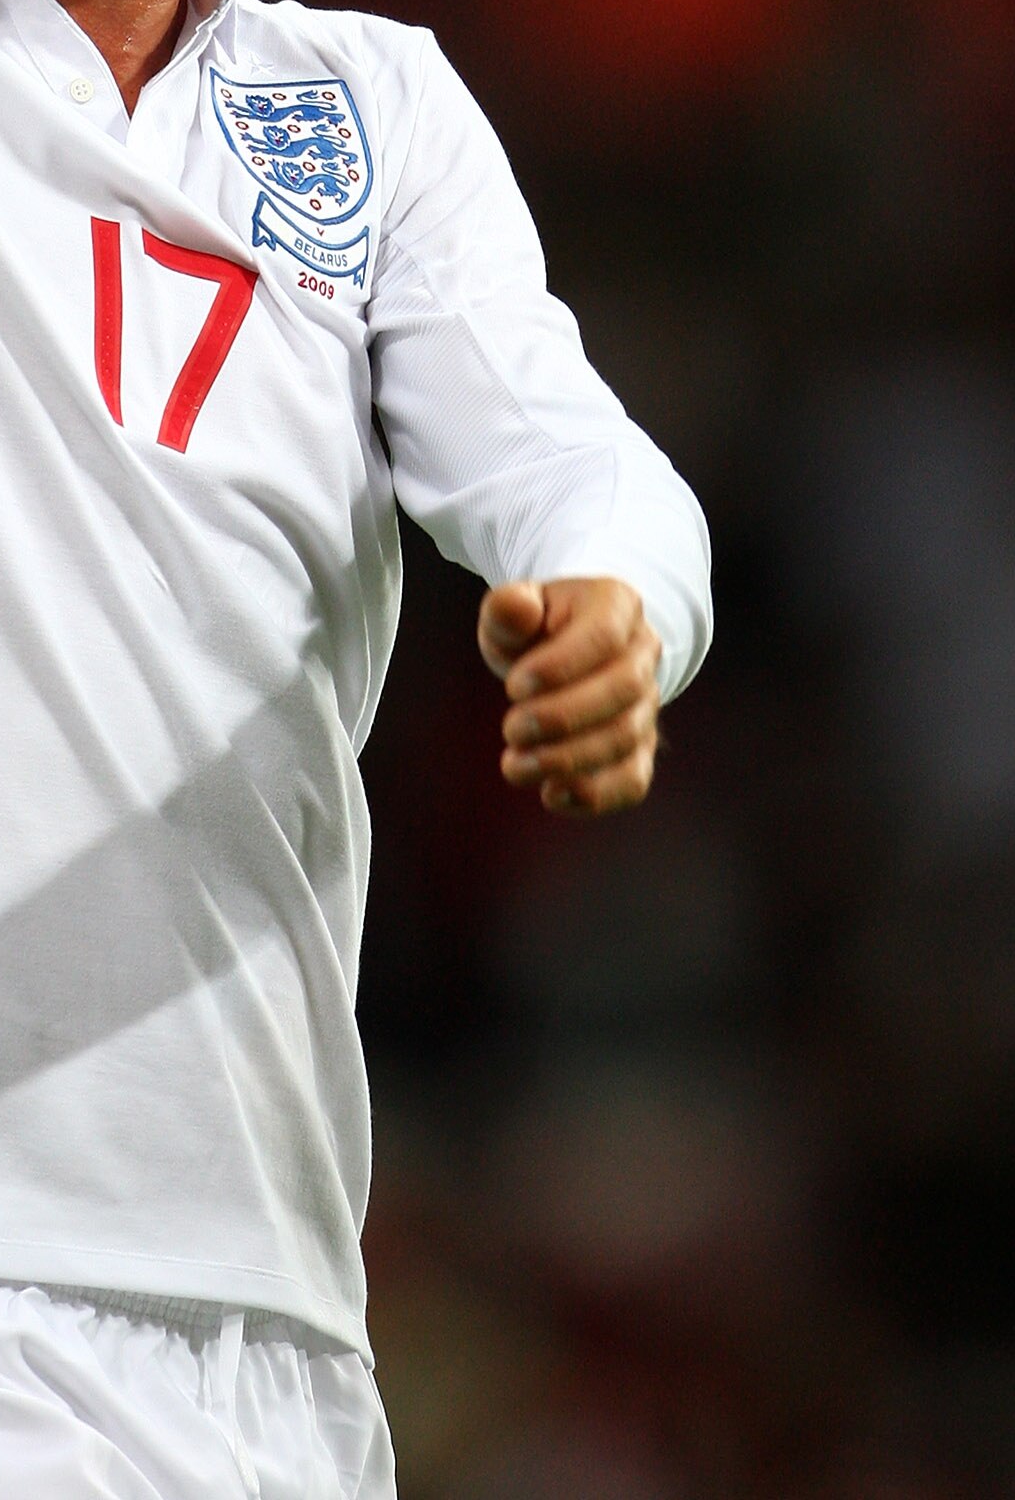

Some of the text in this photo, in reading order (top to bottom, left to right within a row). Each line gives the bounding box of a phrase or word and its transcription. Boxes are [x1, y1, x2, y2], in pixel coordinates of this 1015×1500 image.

[294, 237, 348, 267] BELARUS
[297, 271, 335, 300] 2009
[91, 216, 260, 454] 17
